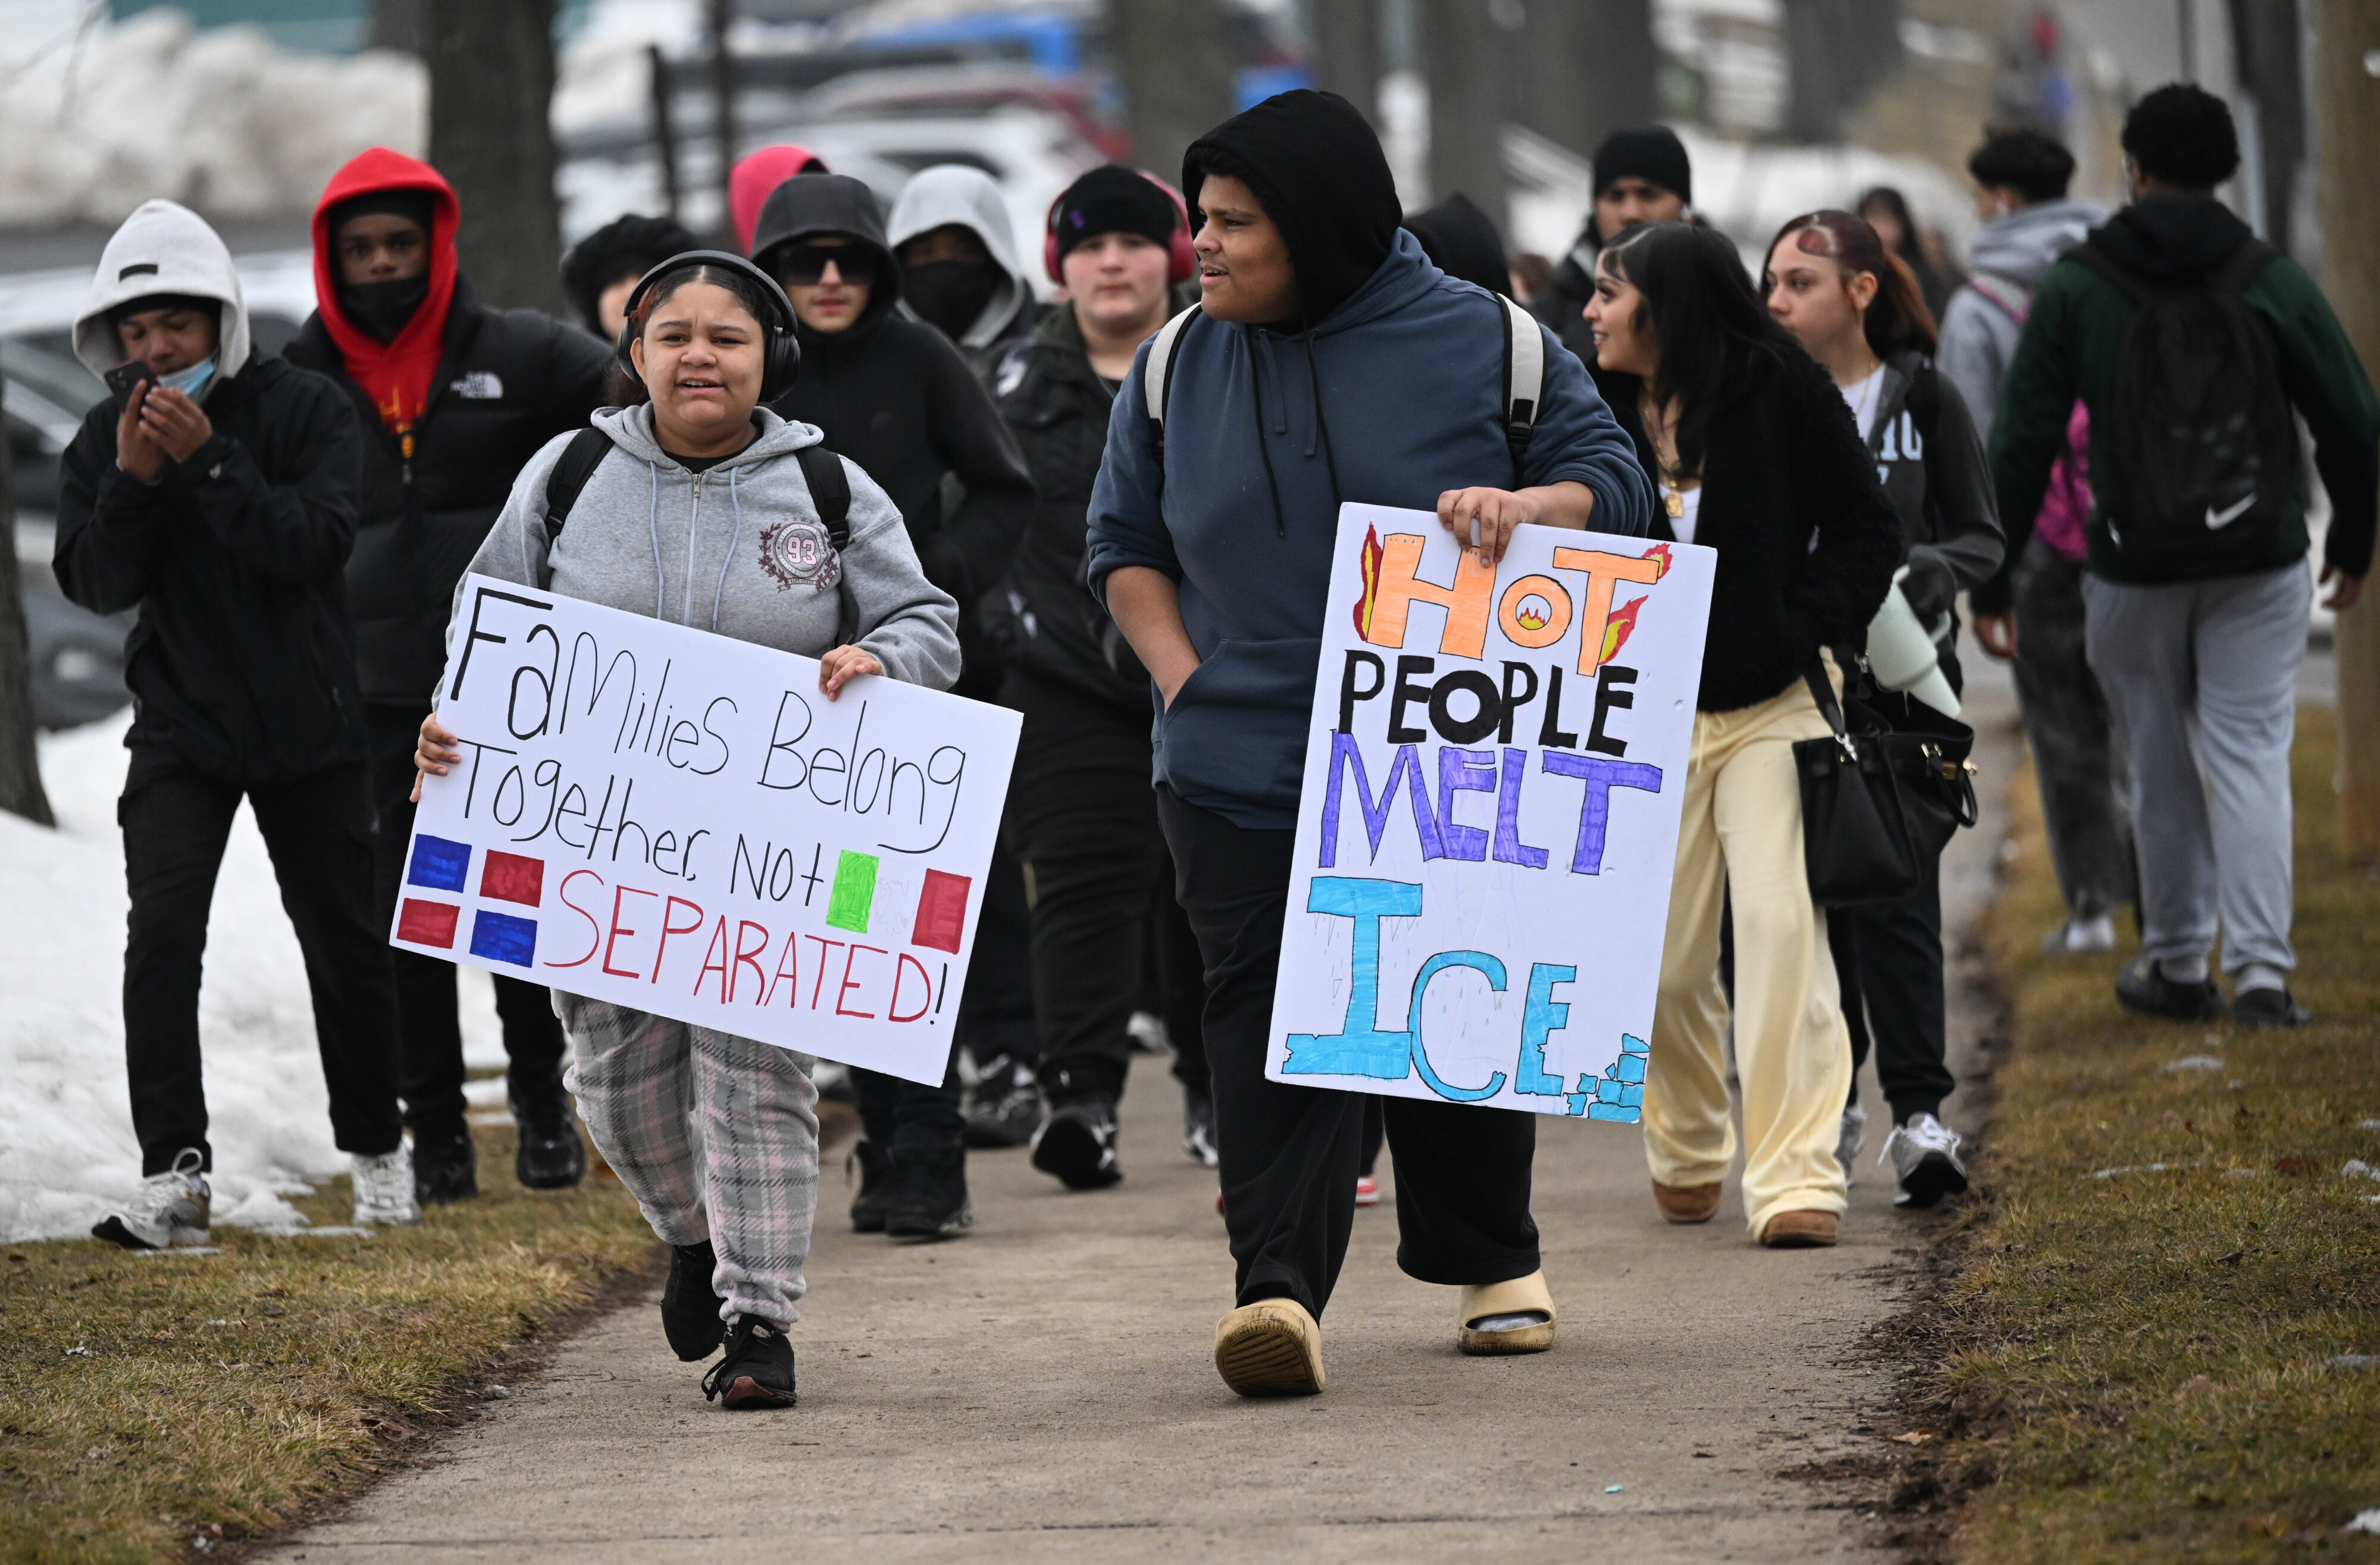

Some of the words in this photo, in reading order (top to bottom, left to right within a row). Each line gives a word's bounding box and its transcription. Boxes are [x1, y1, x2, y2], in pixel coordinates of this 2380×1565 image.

[787, 536, 818, 565] 93
[450, 587, 738, 775] Families
[757, 690, 966, 854] Belong
[1338, 649, 1638, 758] PEOPLE
[1318, 728, 1662, 875] MELT
[544, 869, 948, 1025] SEPARATED!
[1281, 876, 1577, 1101] ICE
